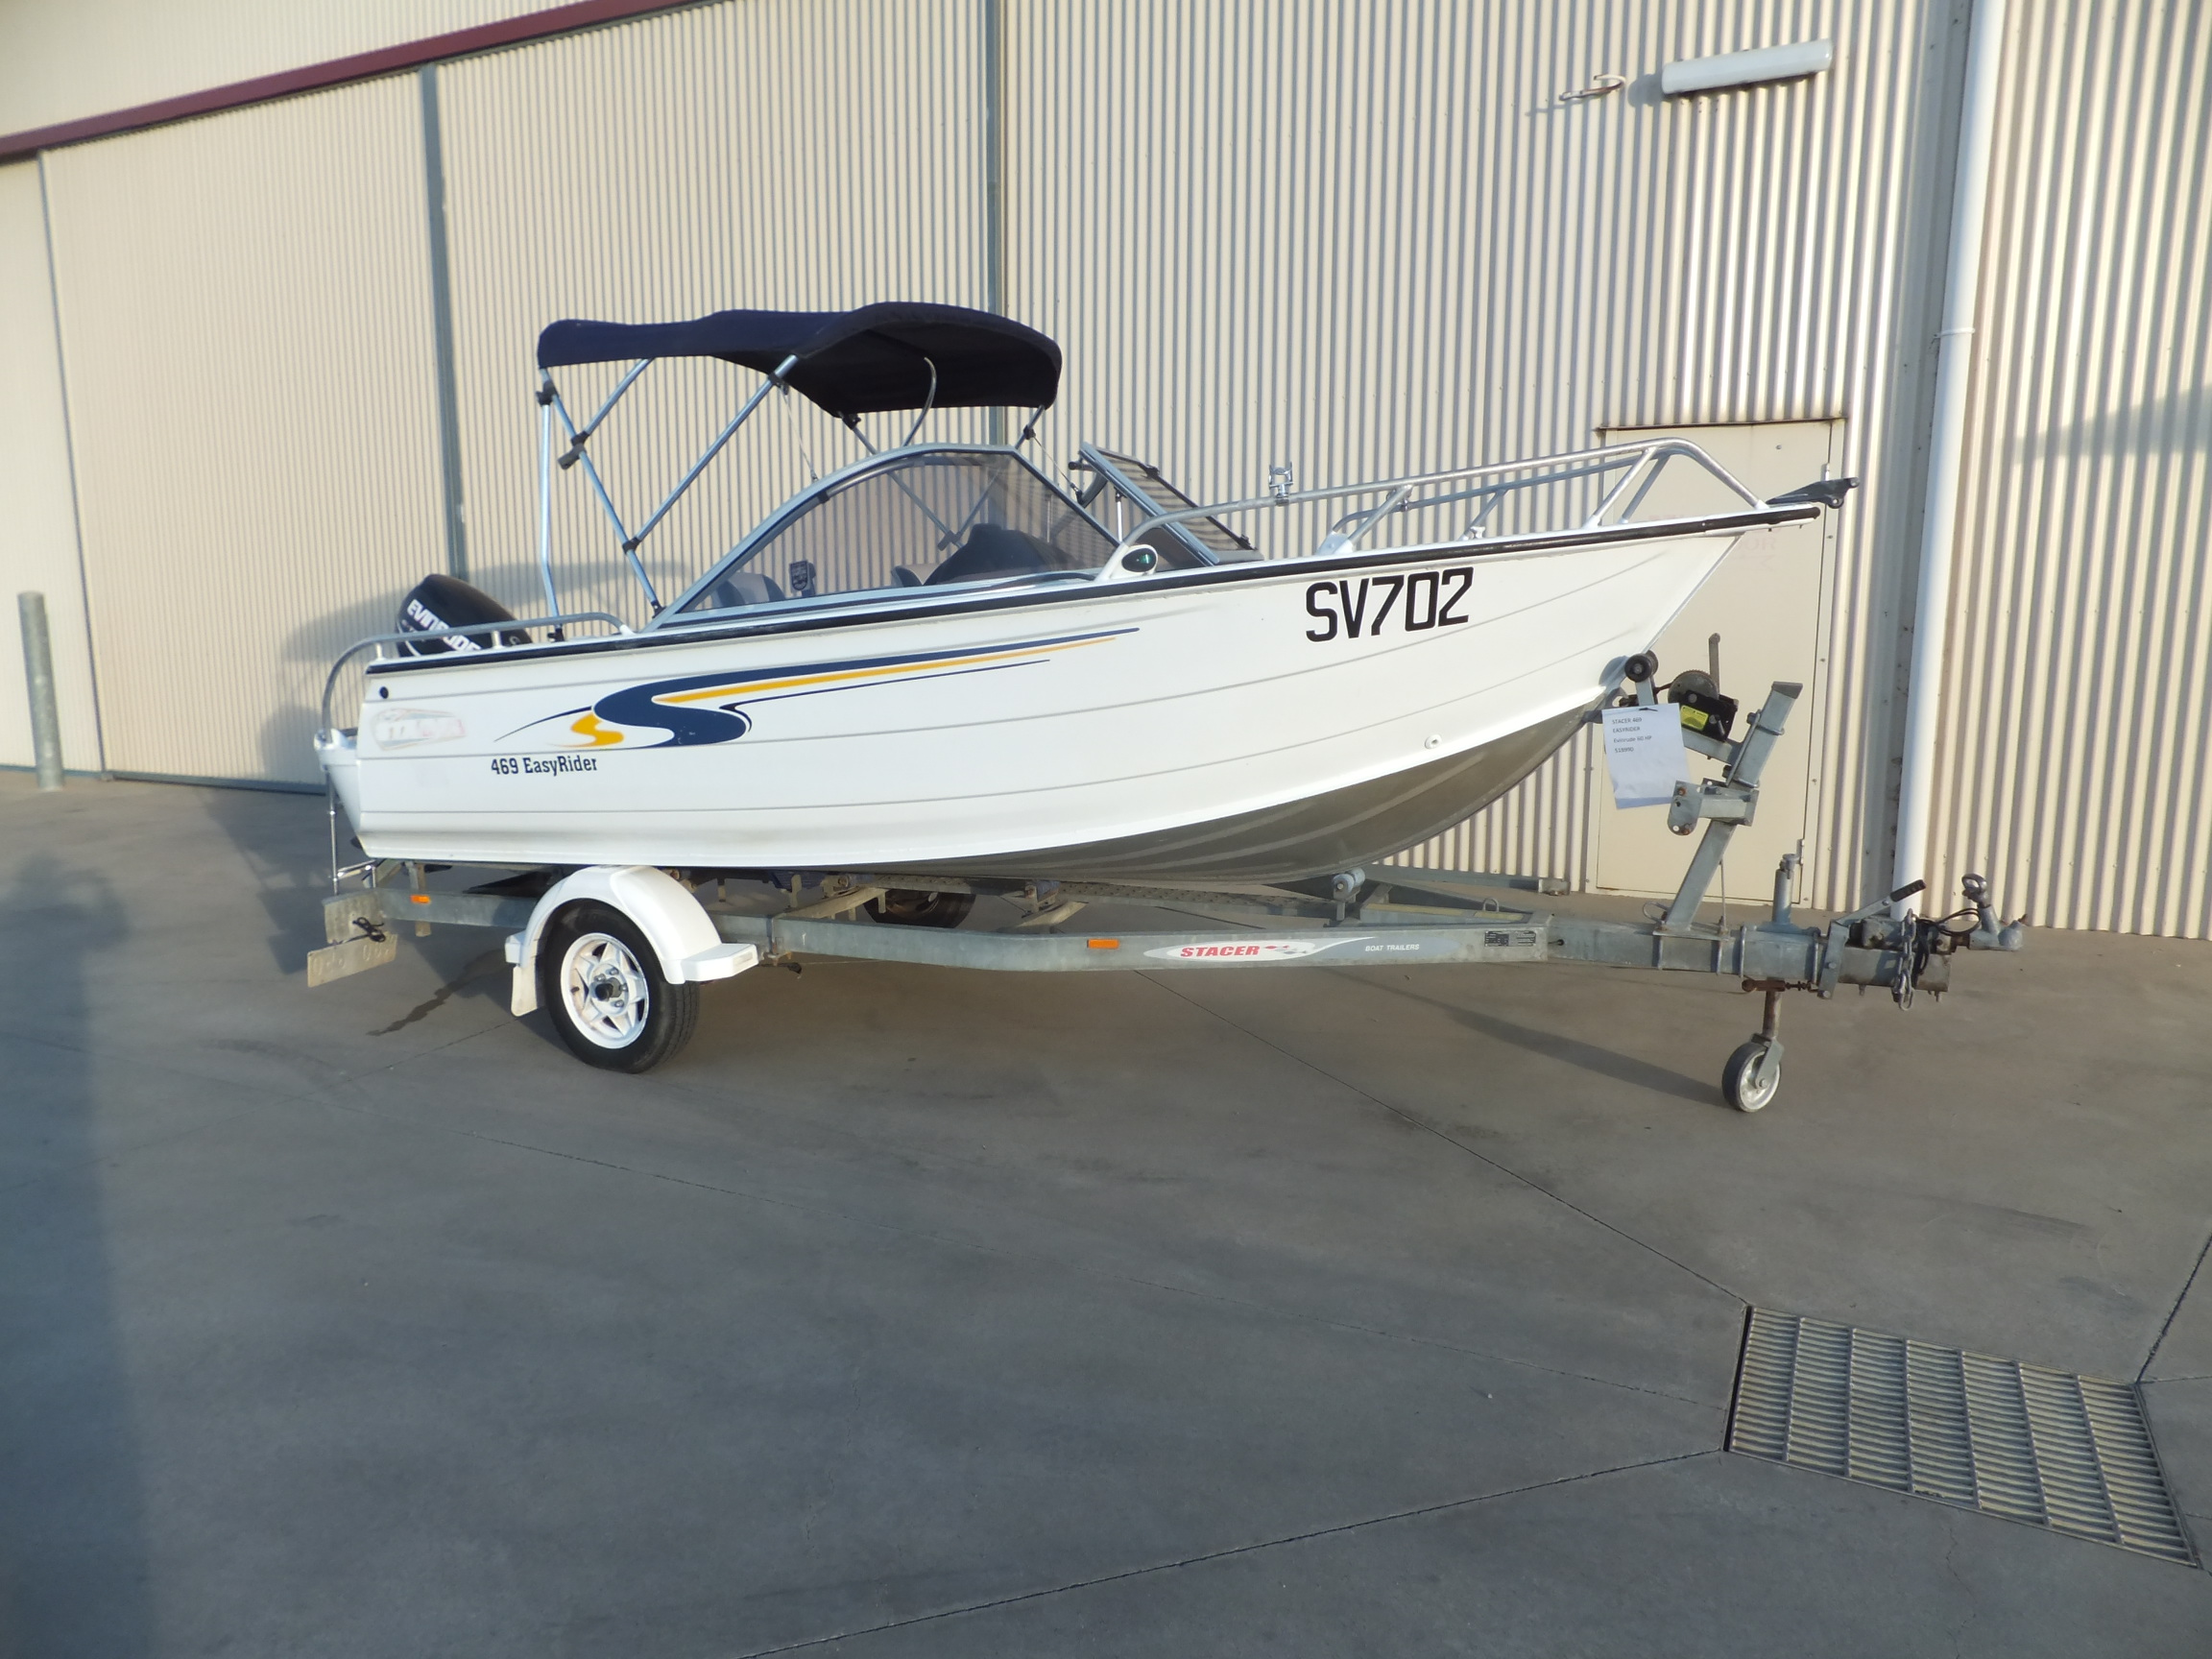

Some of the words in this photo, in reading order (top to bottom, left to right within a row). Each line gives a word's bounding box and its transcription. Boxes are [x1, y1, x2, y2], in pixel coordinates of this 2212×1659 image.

[1306, 566, 1474, 642] SV702
[491, 757, 518, 775] 469
[522, 755, 597, 777] EasyRider
[1180, 946, 1260, 957] STACER
